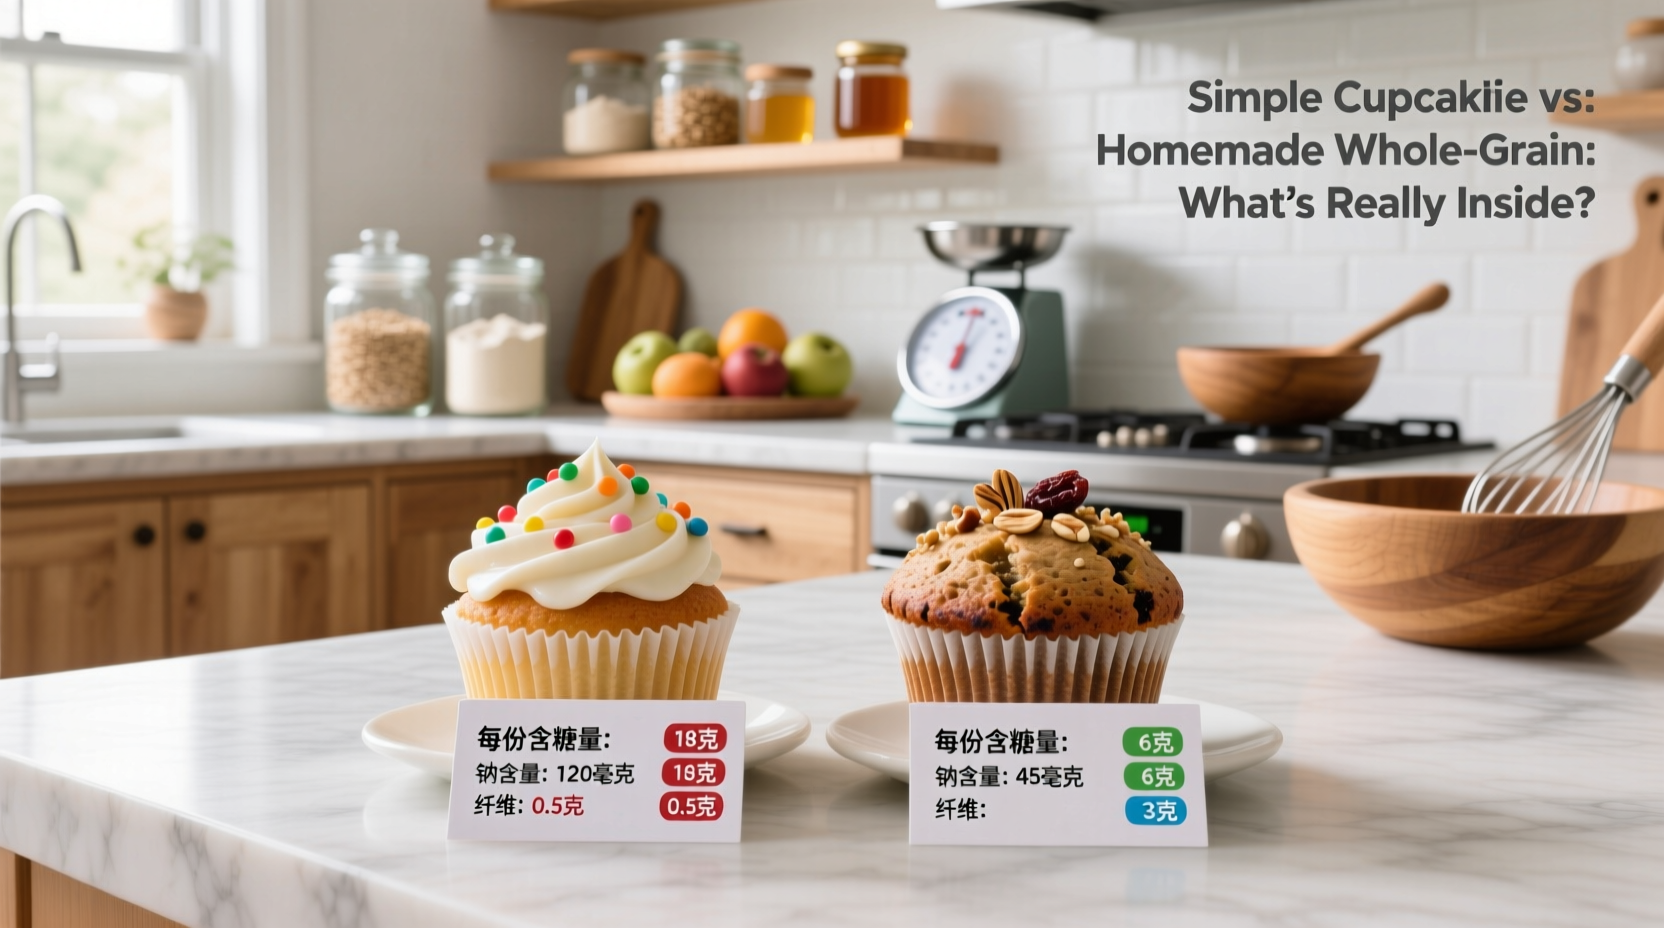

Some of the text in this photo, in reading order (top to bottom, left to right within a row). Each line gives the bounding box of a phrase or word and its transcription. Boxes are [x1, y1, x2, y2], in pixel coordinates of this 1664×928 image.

[675, 727, 719, 751] 18克
[1138, 731, 1174, 754] 6克
[557, 761, 635, 785] 120毫克
[1015, 764, 1084, 788] 45毫克
[1141, 765, 1176, 788] 6克
[531, 794, 585, 816] 0.5克
[667, 794, 717, 817] 0.5克
[1142, 800, 1178, 822] 3克
